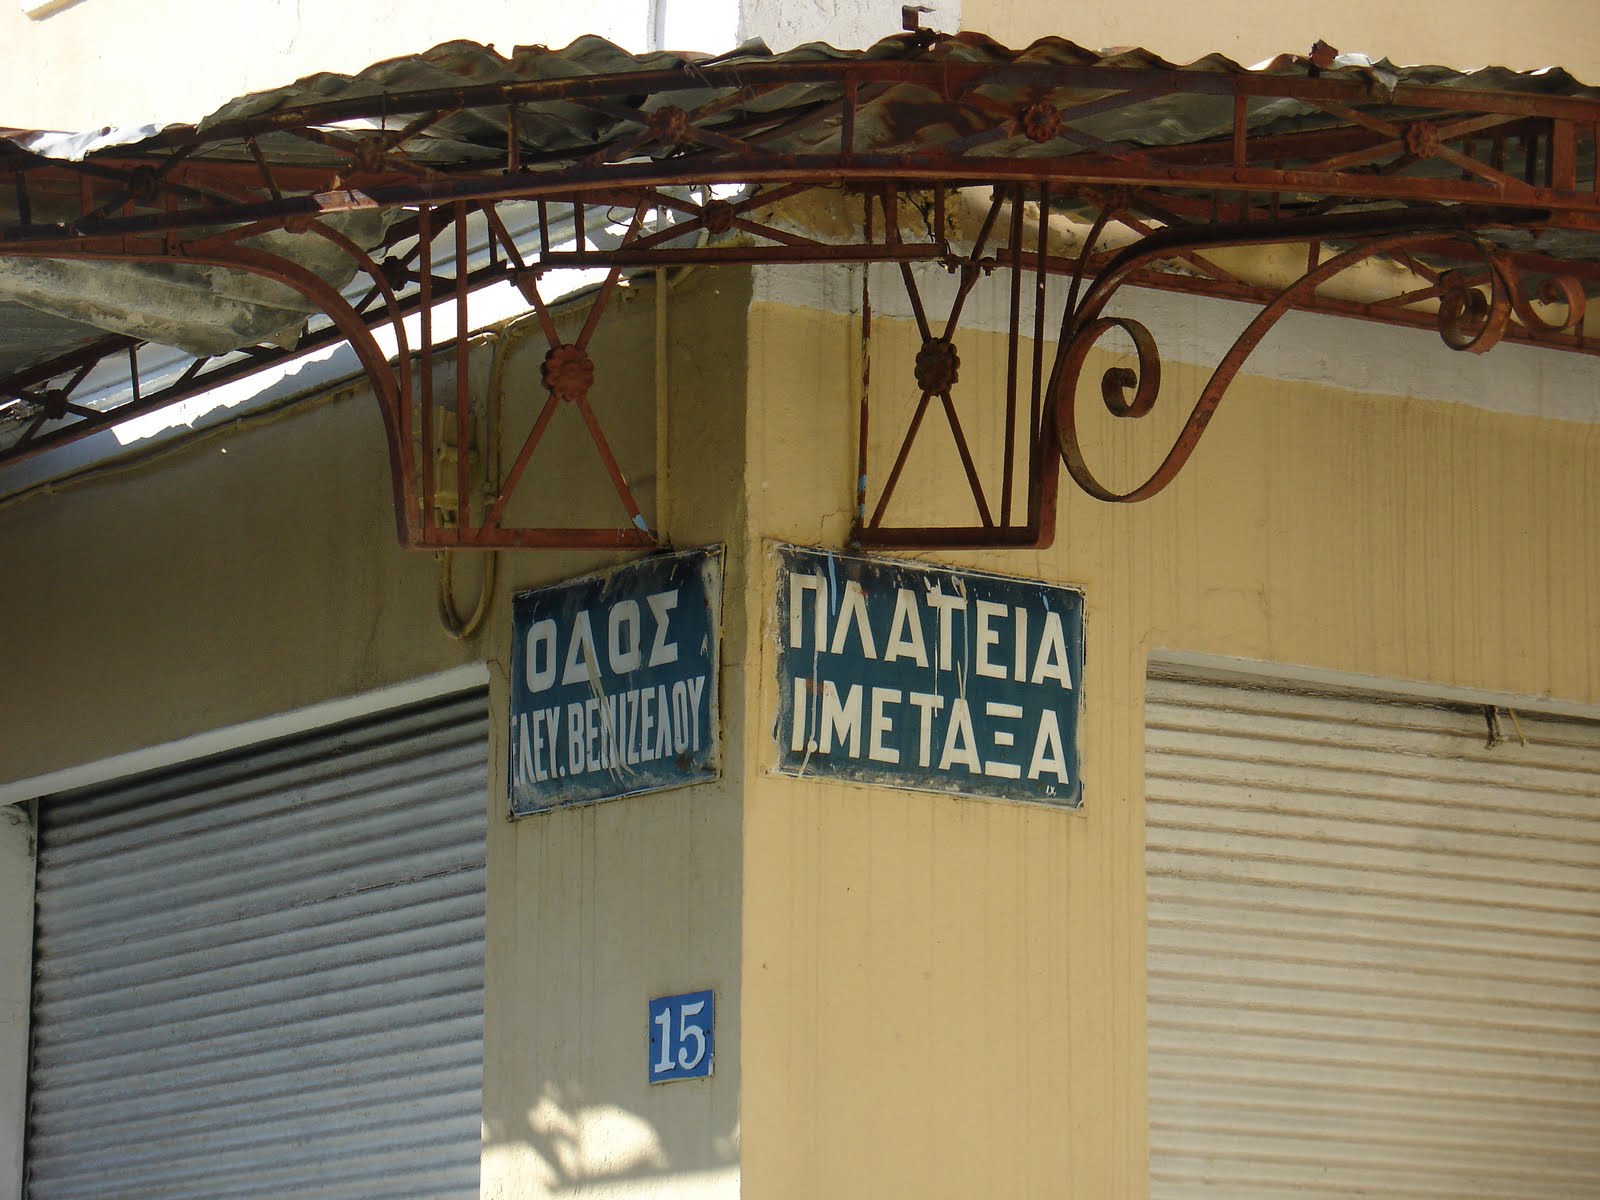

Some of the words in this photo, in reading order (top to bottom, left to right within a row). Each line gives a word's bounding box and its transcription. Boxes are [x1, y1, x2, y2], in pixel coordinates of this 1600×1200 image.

[526, 589, 679, 693] ΟΔΟΣ
[789, 572, 1073, 690] ΠΛΑΤΕΙΑ
[654, 1000, 706, 1073] 15
